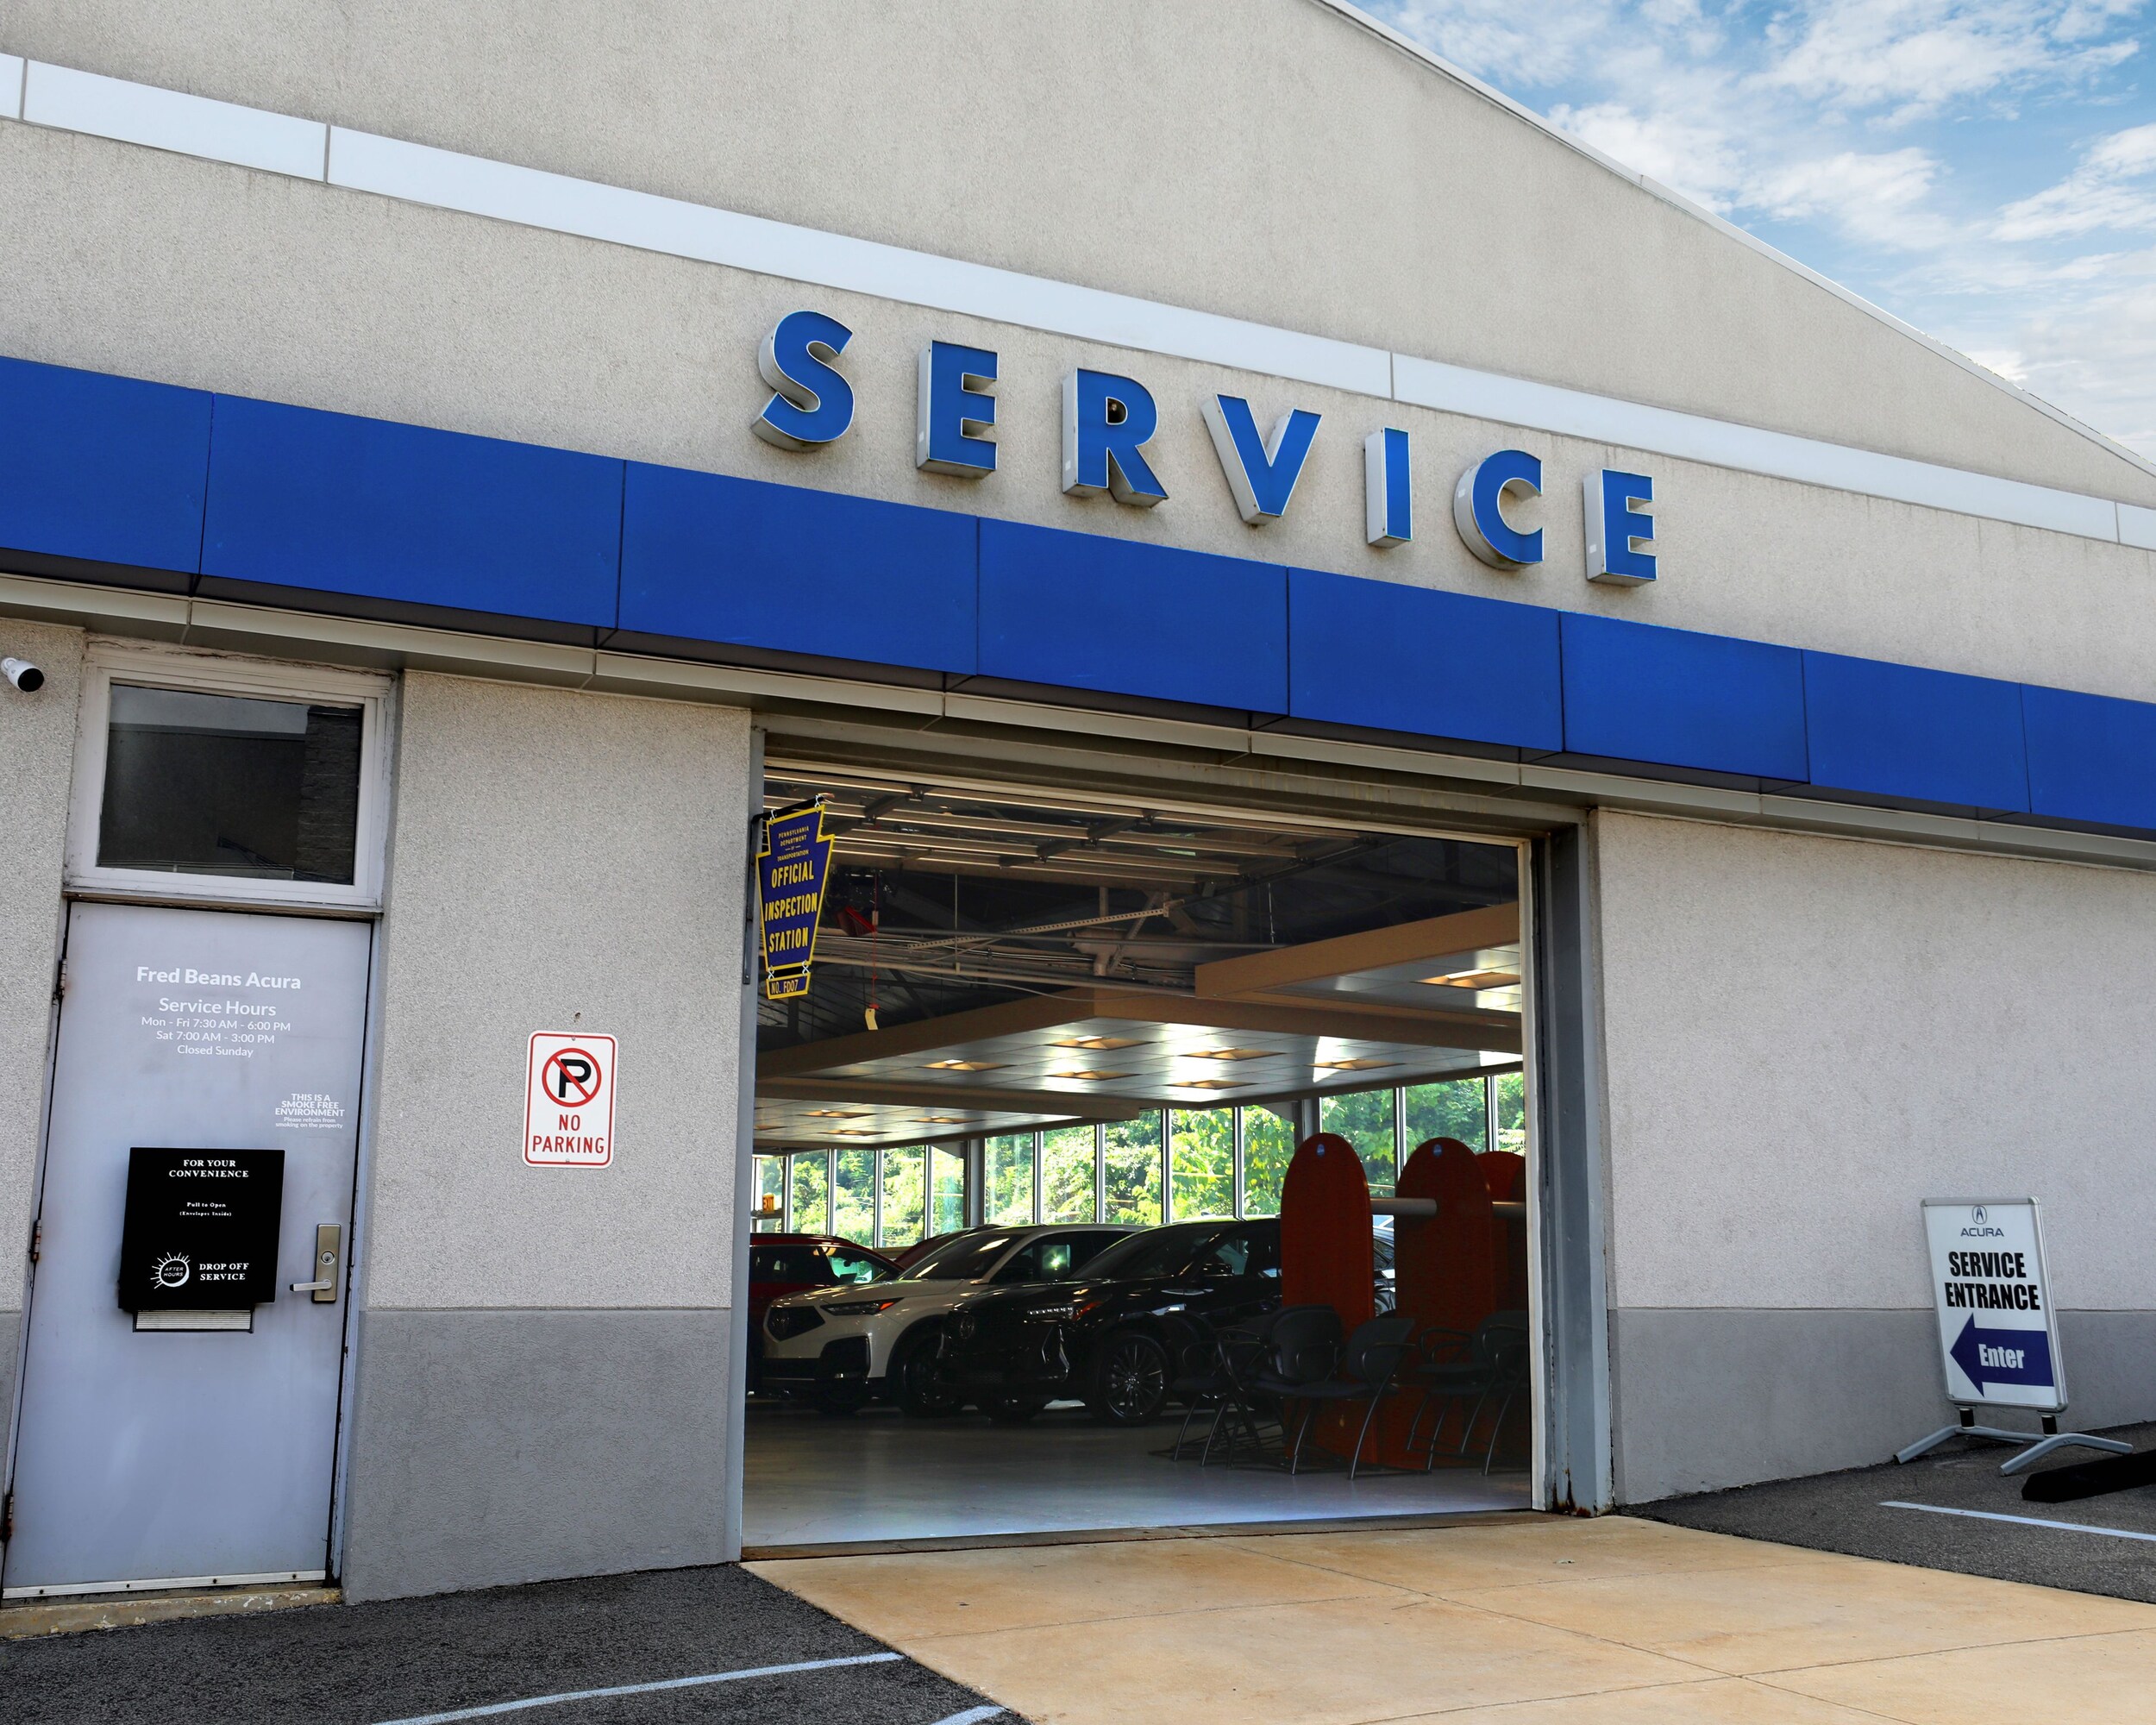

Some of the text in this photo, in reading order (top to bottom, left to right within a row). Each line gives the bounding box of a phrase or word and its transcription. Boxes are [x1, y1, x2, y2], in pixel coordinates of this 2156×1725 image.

[750, 308, 1658, 586] SERVICE
[778, 825, 809, 839] PENNSYLVANIA
[780, 834, 807, 846] DEPARTMENT
[777, 849, 809, 862] TRANSPORTATION
[771, 860, 814, 888] OFFICIAL
[764, 892, 818, 922] INSPECTION
[769, 926, 809, 953] STATION
[136, 966, 301, 989] Fred Beans Acura
[159, 997, 277, 1016] Service Hours
[141, 1017, 166, 1026] Mon
[176, 1018, 190, 1027] Fri
[193, 1019, 216, 1028] 7:30
[218, 1019, 237, 1029] AM
[248, 1021, 271, 1031] 6:00
[273, 1022, 291, 1032] PM
[156, 1031, 173, 1040] Sat
[176, 1032, 199, 1041] 7:00
[202, 1032, 221, 1042] AM
[231, 1033, 254, 1043] 3:00
[257, 1035, 275, 1044] PM
[177, 1044, 254, 1057] Closed Sunday
[291, 1093, 312, 1101] THIS
[275, 1107, 345, 1117] ENVIRONMENT
[559, 1114, 580, 1132] NO
[532, 1135, 605, 1154] PARKING
[168, 1170, 249, 1178] CONVENIENCE
[1960, 1227, 2004, 1237] ACURA
[1948, 1251, 2027, 1278] SERVICE
[1945, 1282, 2041, 1311] ENTRANCE
[1978, 1343, 2025, 1370] Enter
